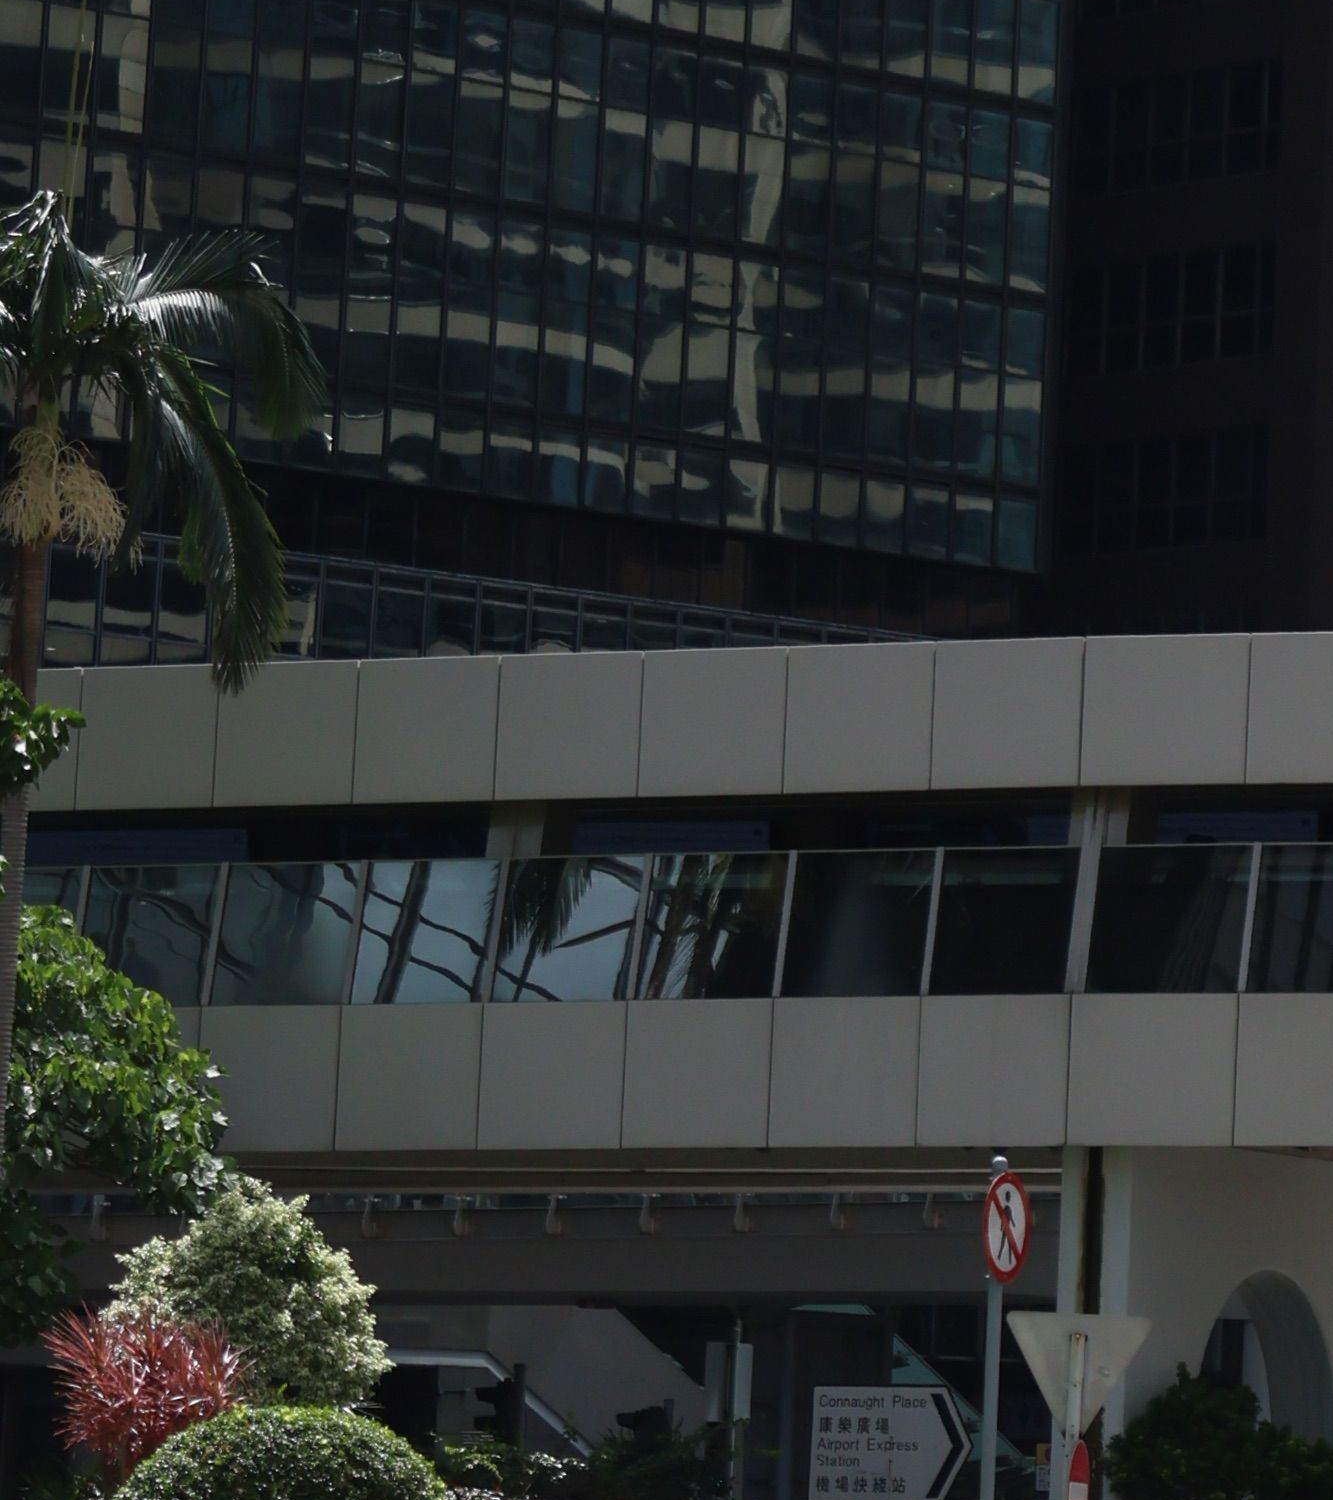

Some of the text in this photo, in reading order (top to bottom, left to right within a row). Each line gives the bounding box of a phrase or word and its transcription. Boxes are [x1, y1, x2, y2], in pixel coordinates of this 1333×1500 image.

[819, 1393, 928, 1411] Connaught Place
[817, 1438, 919, 1452] Airport Express
[816, 1454, 860, 1467] Station
